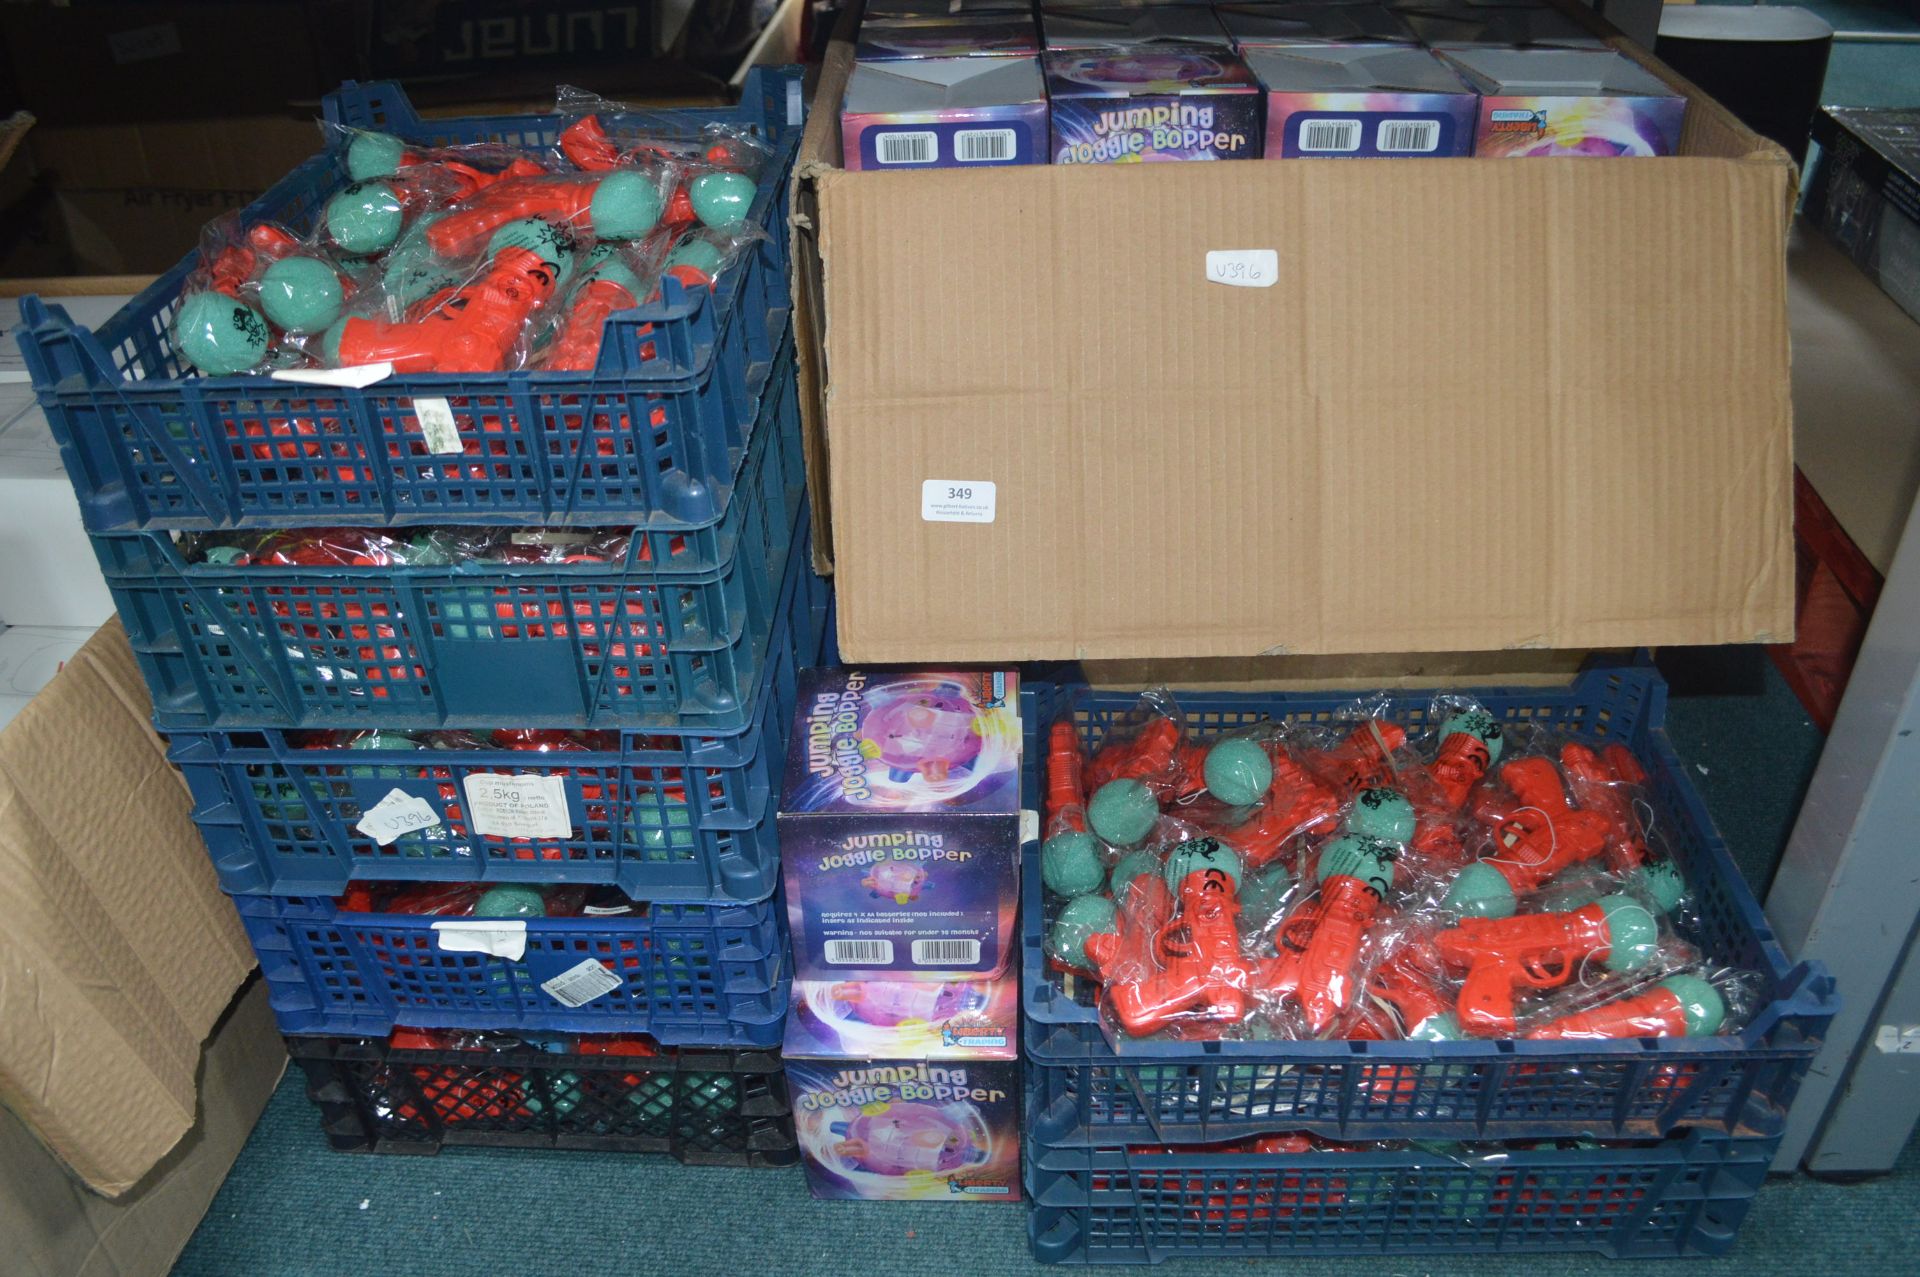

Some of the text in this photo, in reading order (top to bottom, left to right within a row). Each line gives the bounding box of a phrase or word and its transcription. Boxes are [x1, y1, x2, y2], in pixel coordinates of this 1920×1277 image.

[1152, 129, 1245, 152] Bopper
[948, 488, 972, 499] 349
[892, 848, 972, 863] Bopper
[833, 1063, 968, 1088] Jumping
[900, 1085, 1006, 1103] Bopper
